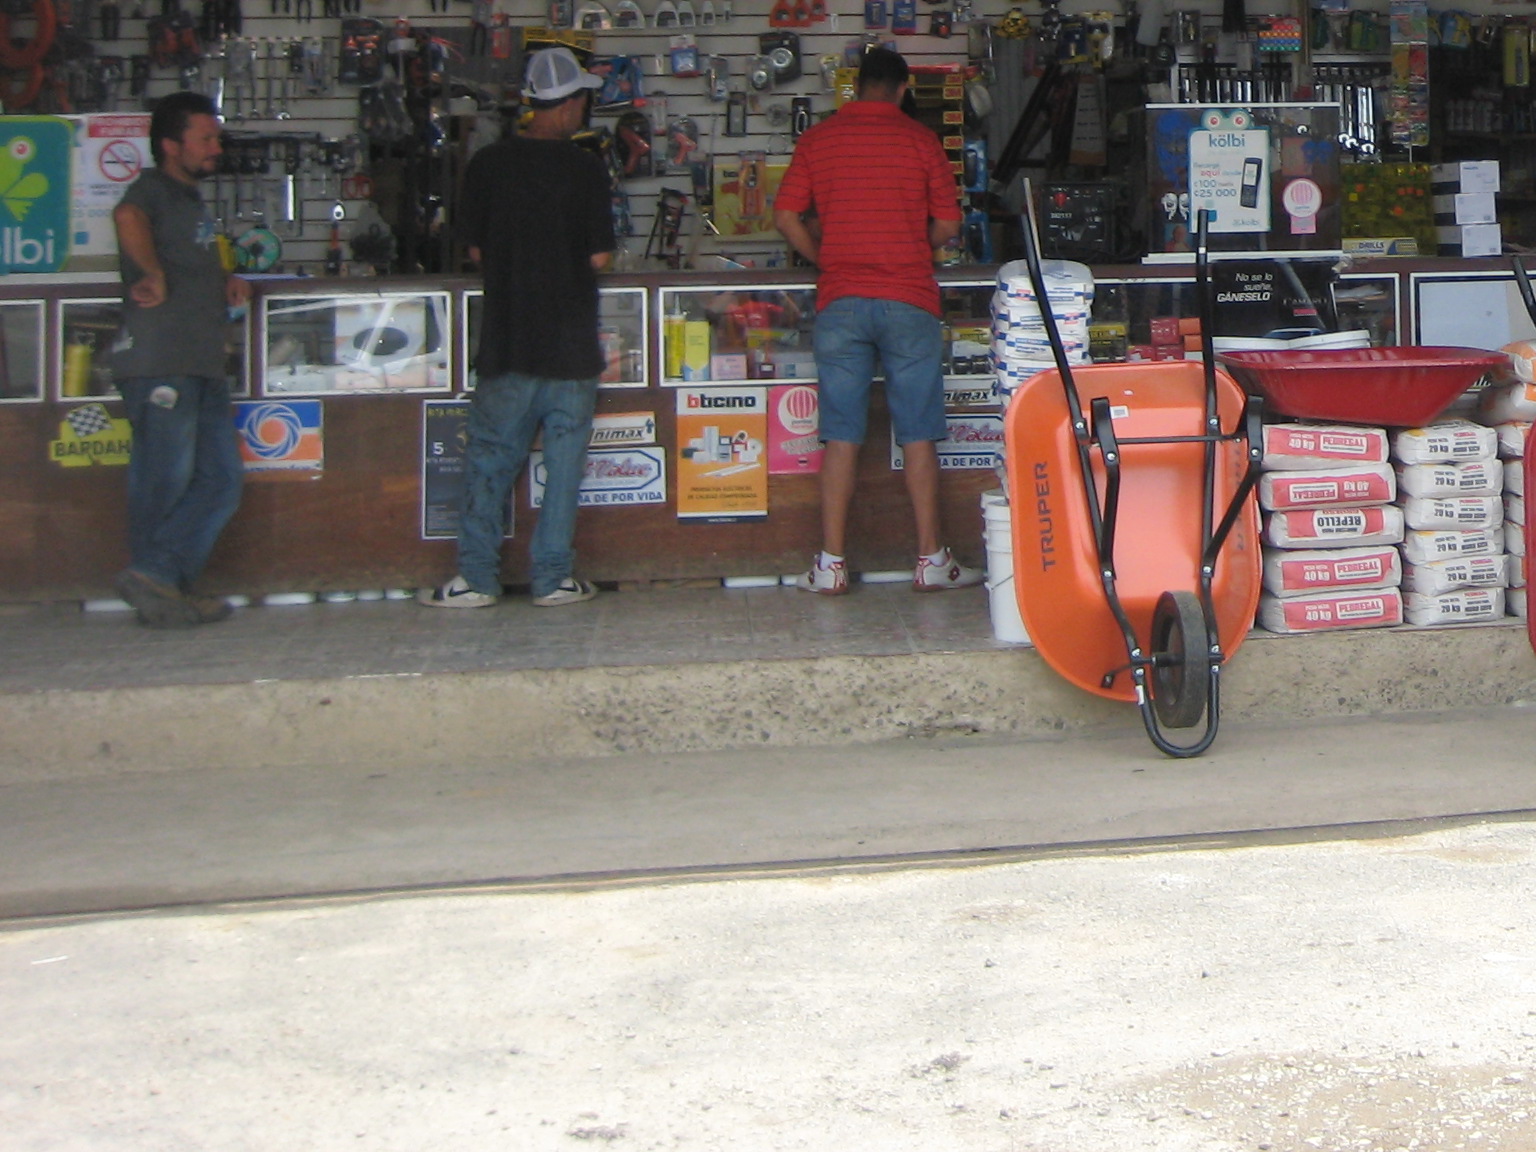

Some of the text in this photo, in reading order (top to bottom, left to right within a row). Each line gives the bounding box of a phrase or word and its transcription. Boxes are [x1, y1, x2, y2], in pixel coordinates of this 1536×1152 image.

[0, 226, 55, 265] lbi
[1235, 272, 1274, 282] No se lo
[687, 393, 757, 409] bticino
[591, 429, 644, 441] nimax
[54, 441, 131, 457] BARDAH
[1032, 460, 1057, 572] TRUPER
[1316, 515, 1362, 527] REPELLO
[1303, 570, 1317, 581] 40
[1305, 610, 1319, 621] 40
